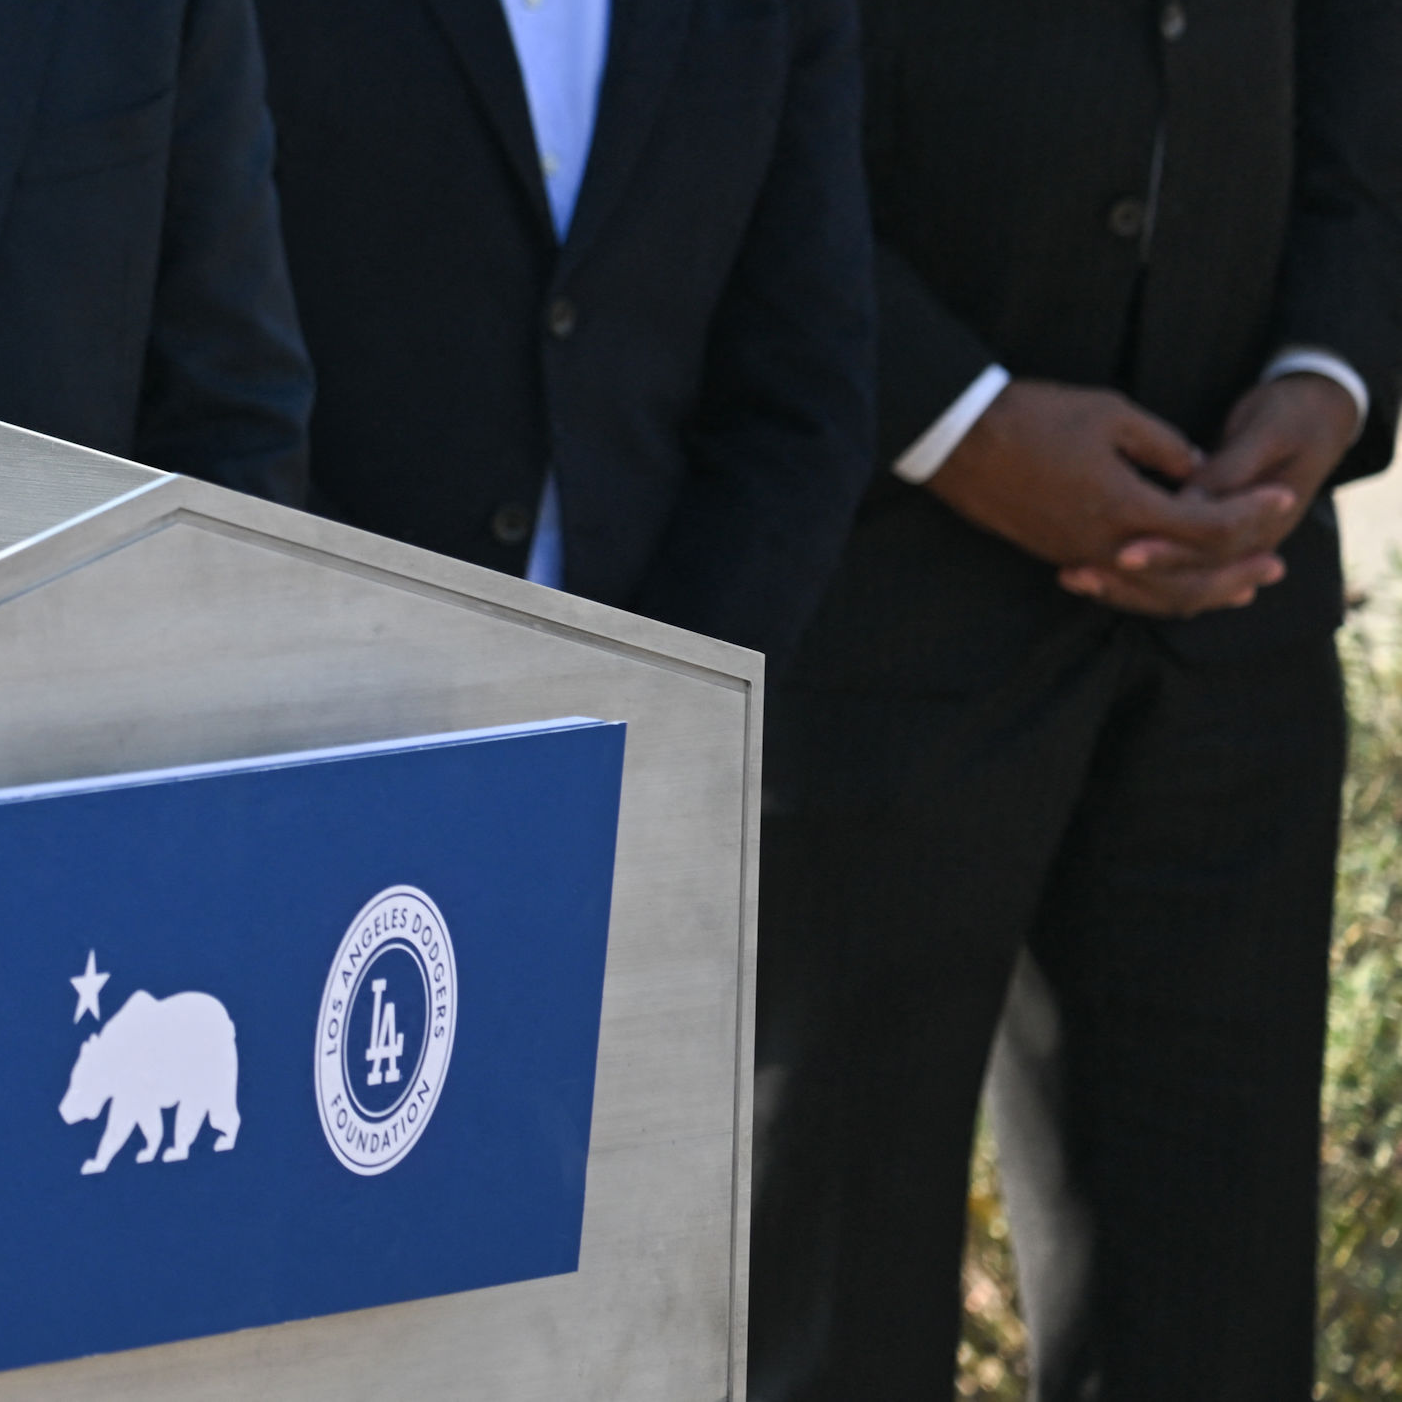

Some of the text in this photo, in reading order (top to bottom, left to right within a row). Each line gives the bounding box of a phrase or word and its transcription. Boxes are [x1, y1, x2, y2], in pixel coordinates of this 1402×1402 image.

[326, 907, 446, 1057] LOS ANGELES DODGERS
[365, 978, 404, 1086] LA
[330, 1080, 430, 1154] FOUNDATION
